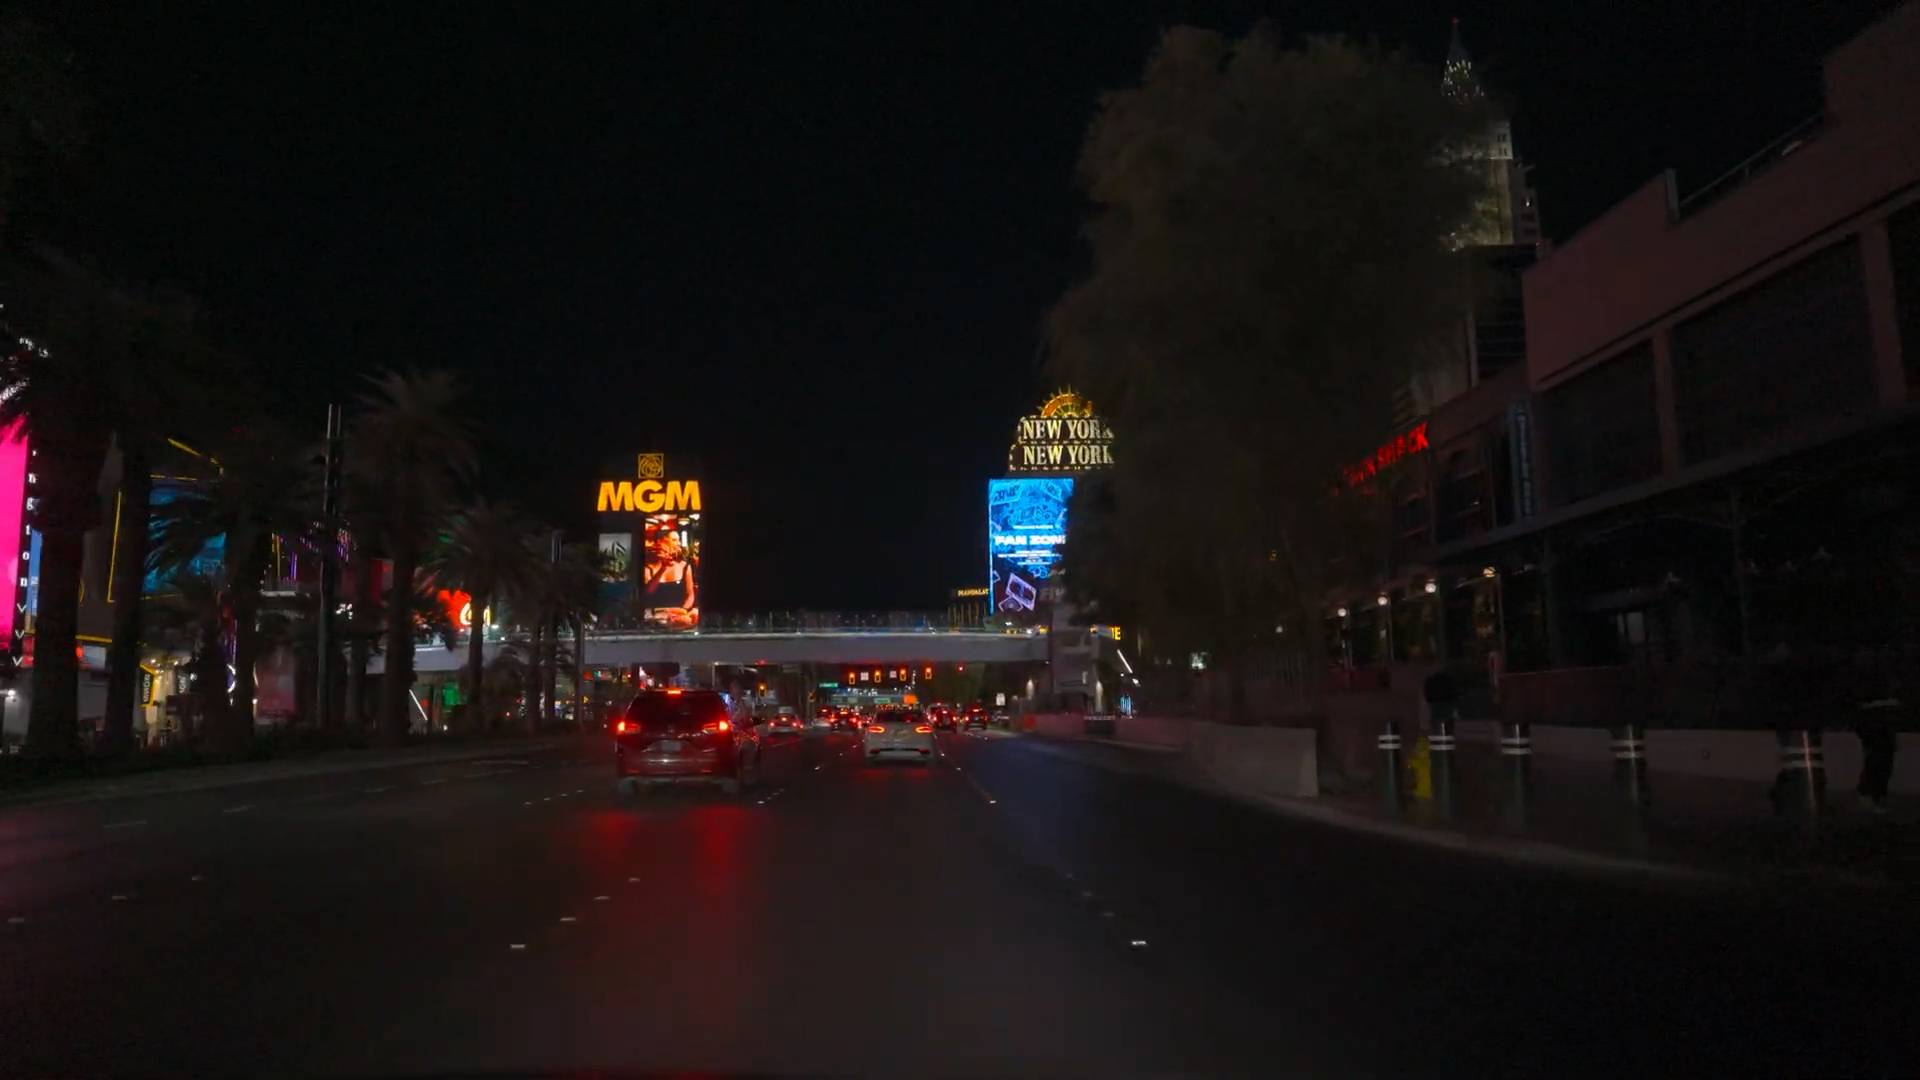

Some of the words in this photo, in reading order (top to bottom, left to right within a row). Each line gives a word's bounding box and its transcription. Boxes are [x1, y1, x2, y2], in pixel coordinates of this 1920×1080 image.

[1023, 419, 1062, 440] NEW
[1023, 445, 1064, 465] NEW
[598, 480, 701, 513] MGM
[994, 534, 1027, 545] FAN
